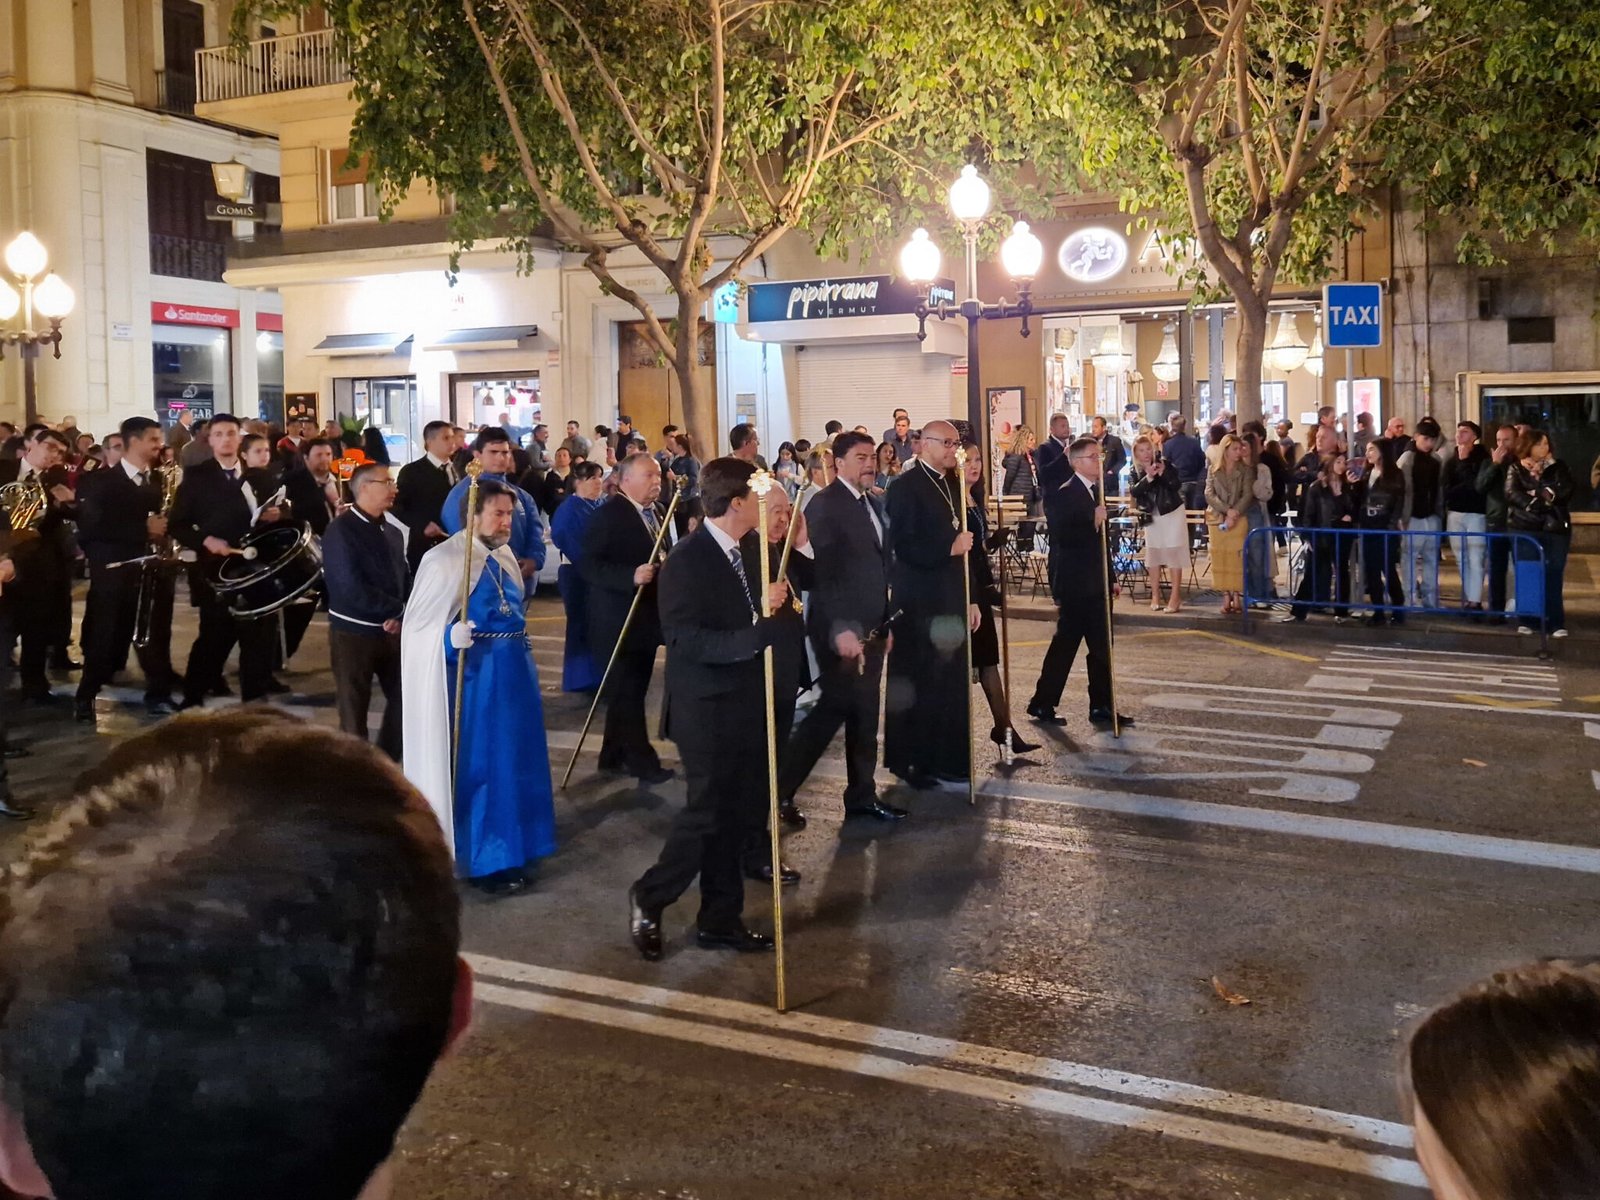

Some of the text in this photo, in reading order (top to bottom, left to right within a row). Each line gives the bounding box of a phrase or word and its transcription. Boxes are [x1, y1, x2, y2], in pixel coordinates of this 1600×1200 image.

[786, 280, 879, 319] pipirrana
[178, 308, 229, 324] Santander
[817, 305, 877, 316] VERMUT
[1329, 305, 1379, 326] TAXI
